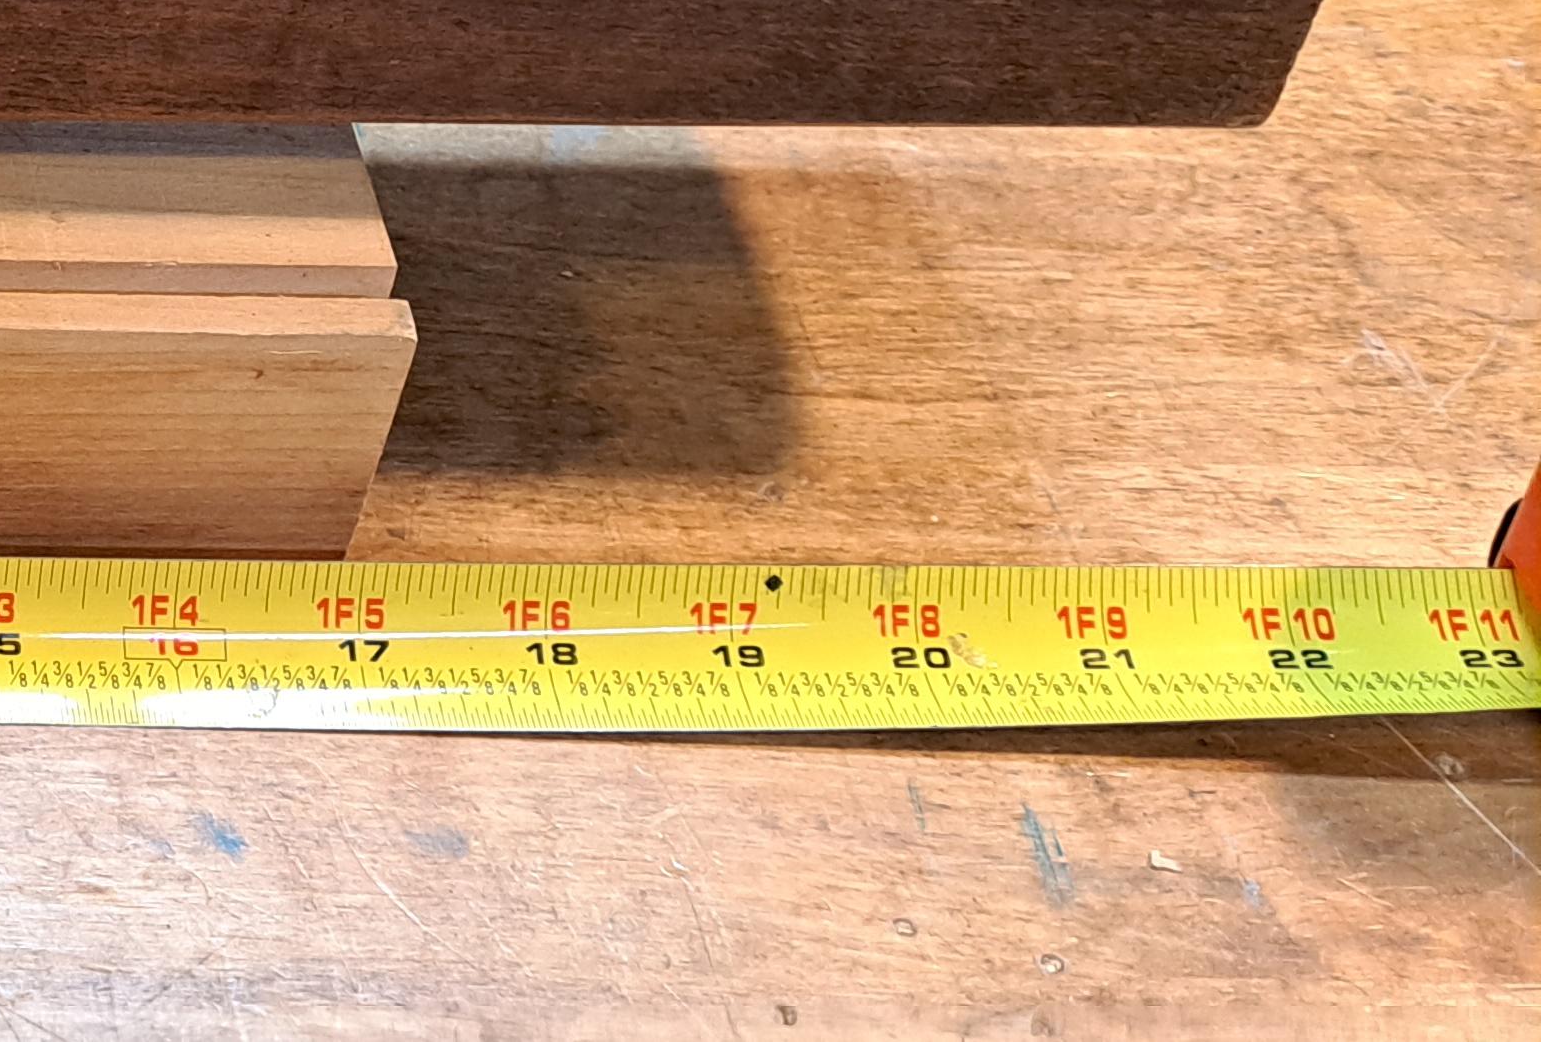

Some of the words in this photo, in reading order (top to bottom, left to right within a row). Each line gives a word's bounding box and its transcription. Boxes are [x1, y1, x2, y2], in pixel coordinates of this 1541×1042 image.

[151, 633, 200, 657] 16
[338, 639, 390, 662] 17
[525, 642, 579, 666] 18
[711, 645, 766, 668] 19
[891, 647, 952, 669] 20
[1079, 648, 1136, 669] 21
[1267, 649, 1333, 669] 22
[1459, 649, 1524, 668] 23
